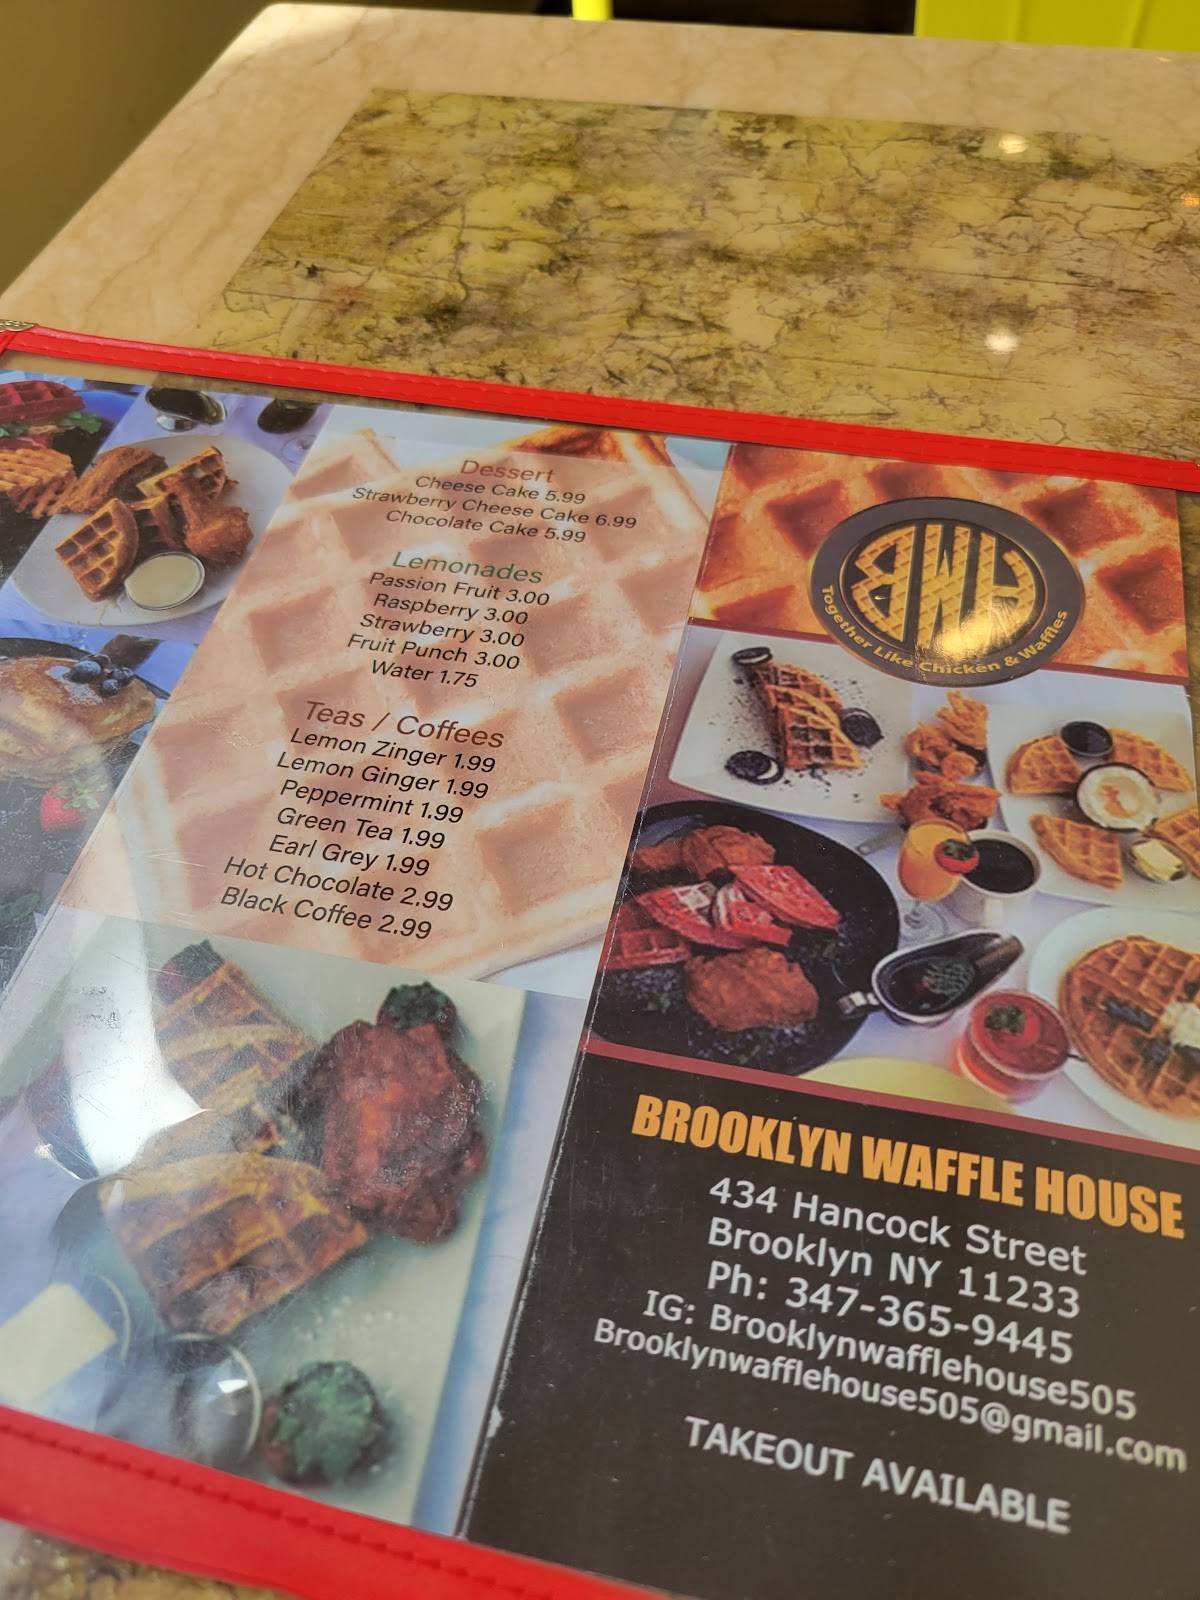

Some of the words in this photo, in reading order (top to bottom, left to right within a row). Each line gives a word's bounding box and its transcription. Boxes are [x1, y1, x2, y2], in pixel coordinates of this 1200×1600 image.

[416, 476, 485, 495] Cheese
[492, 485, 539, 499] Cake
[545, 490, 585, 504] 5.99
[460, 460, 556, 482] Dessert
[352, 488, 455, 511] Strawberry
[462, 499, 533, 519] Cheese
[540, 508, 588, 524] Cake
[595, 514, 637, 529] 6.99
[386, 510, 482, 532] Chocolate
[489, 521, 538, 537] Cake
[544, 528, 586, 542] 5.99
[369, 572, 446, 592] Passion
[453, 582, 501, 600] Fruit
[505, 589, 549, 606] 3.00
[392, 552, 543, 584] Lemonades
[360, 614, 473, 642] Strawberry
[479, 630, 524, 647] 3.00
[373, 593, 478, 621] Raspberry
[483, 608, 528, 625] 3.00
[822, 584, 872, 649] Together
[873, 646, 912, 669] Like
[919, 661, 1000, 674] Chicken
[1004, 656, 1020, 668] &
[1017, 609, 1068, 659] Waffles
[347, 634, 396, 653] Fruit
[401, 642, 467, 662] Punch
[474, 652, 520, 670] 3.00
[372, 660, 433, 681] Water
[439, 670, 478, 688] 1.75
[305, 701, 365, 727] Teas
[372, 713, 390, 731] /
[397, 715, 504, 748] Coffees
[291, 728, 366, 754] Lemon
[372, 740, 447, 766] Zinger
[454, 754, 495, 772] 1.99
[277, 752, 354, 778] Lemon
[361, 765, 439, 792] Ginger
[446, 779, 489, 798] 1.99
[280, 779, 413, 815] Peppermint
[421, 803, 463, 823] 1.99
[277, 807, 346, 833] Green
[356, 819, 393, 841] Tea
[402, 828, 445, 849] 1.99
[269, 835, 317, 858] Earl
[322, 843, 379, 871] Grey
[386, 854, 430, 876] 1.99
[224, 857, 268, 880] Hot
[274, 865, 394, 901] Chocolate
[400, 887, 453, 911] 2.99
[220, 886, 286, 914] Black
[294, 899, 372, 929] Coffee
[378, 915, 432, 939] 2.99
[631, 1094, 852, 1174] BROOKLYN
[861, 1135, 1024, 1206] WAFFLE
[1034, 1167, 1185, 1239] HOUSE
[709, 1178, 779, 1213] 434
[793, 1191, 952, 1247] Hancock
[966, 1224, 1088, 1276] Street
[707, 1218, 874, 1277] Brooklyn
[889, 1256, 942, 1288] NY
[958, 1266, 1080, 1318] 11233
[707, 1260, 769, 1300] Ph:
[784, 1277, 1074, 1364] 347-365-9445
[643, 1290, 696, 1325] IG:
[709, 1304, 1137, 1421] Brooklynwafflehouse505
[594, 1318, 1187, 1473] Brooklynwafflehouse505@gmail.com
[685, 1416, 854, 1481] TAKEOUT
[862, 1458, 1072, 1535] AVAILABLE
